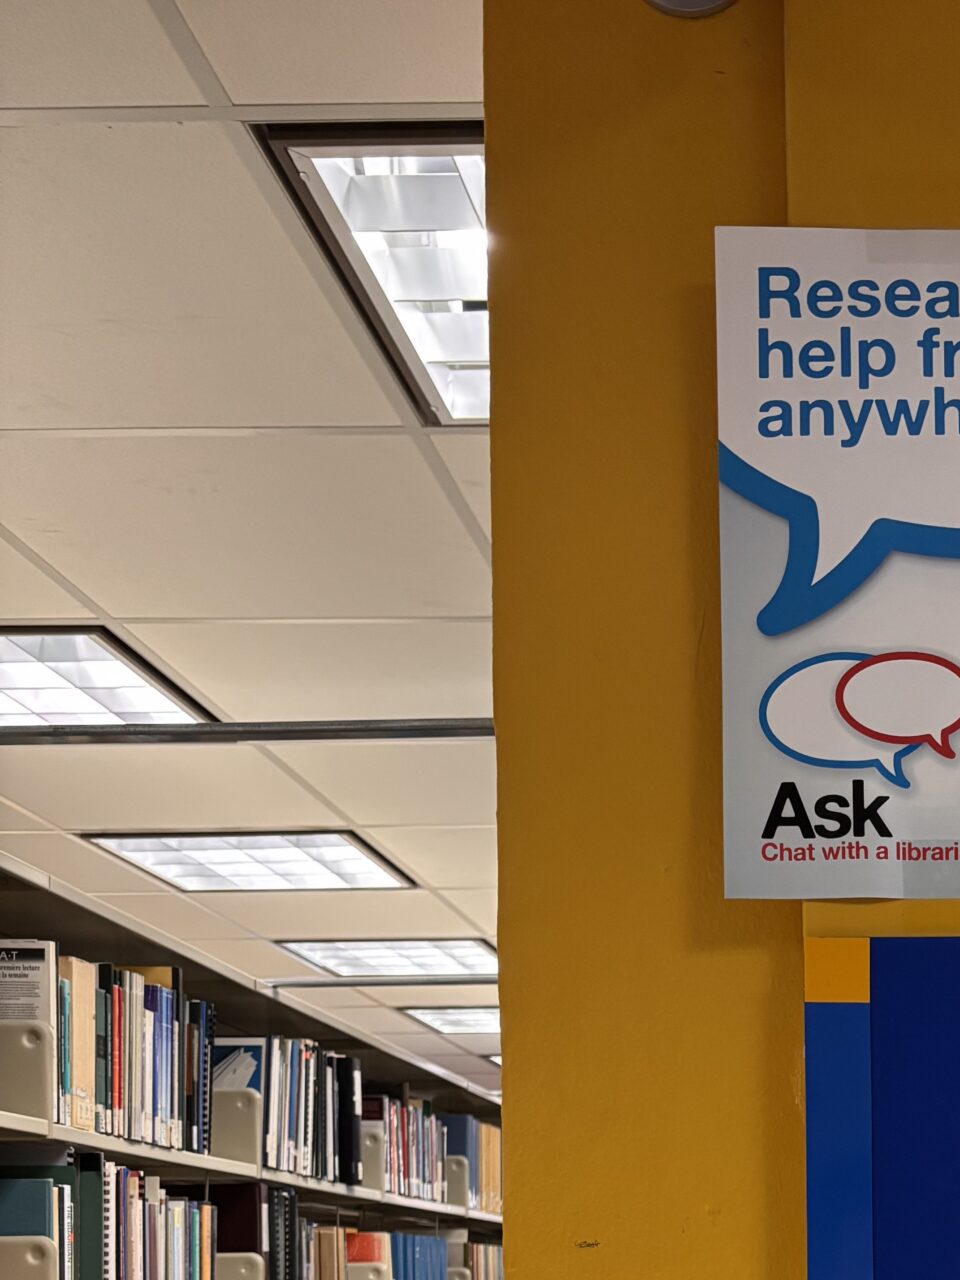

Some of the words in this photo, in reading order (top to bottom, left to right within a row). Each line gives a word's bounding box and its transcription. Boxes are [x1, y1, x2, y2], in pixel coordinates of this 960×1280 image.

[757, 327, 896, 390] help
[761, 779, 893, 840] Ask
[761, 841, 816, 862] Chat
[821, 841, 869, 861] with
[875, 846, 889, 861] a
